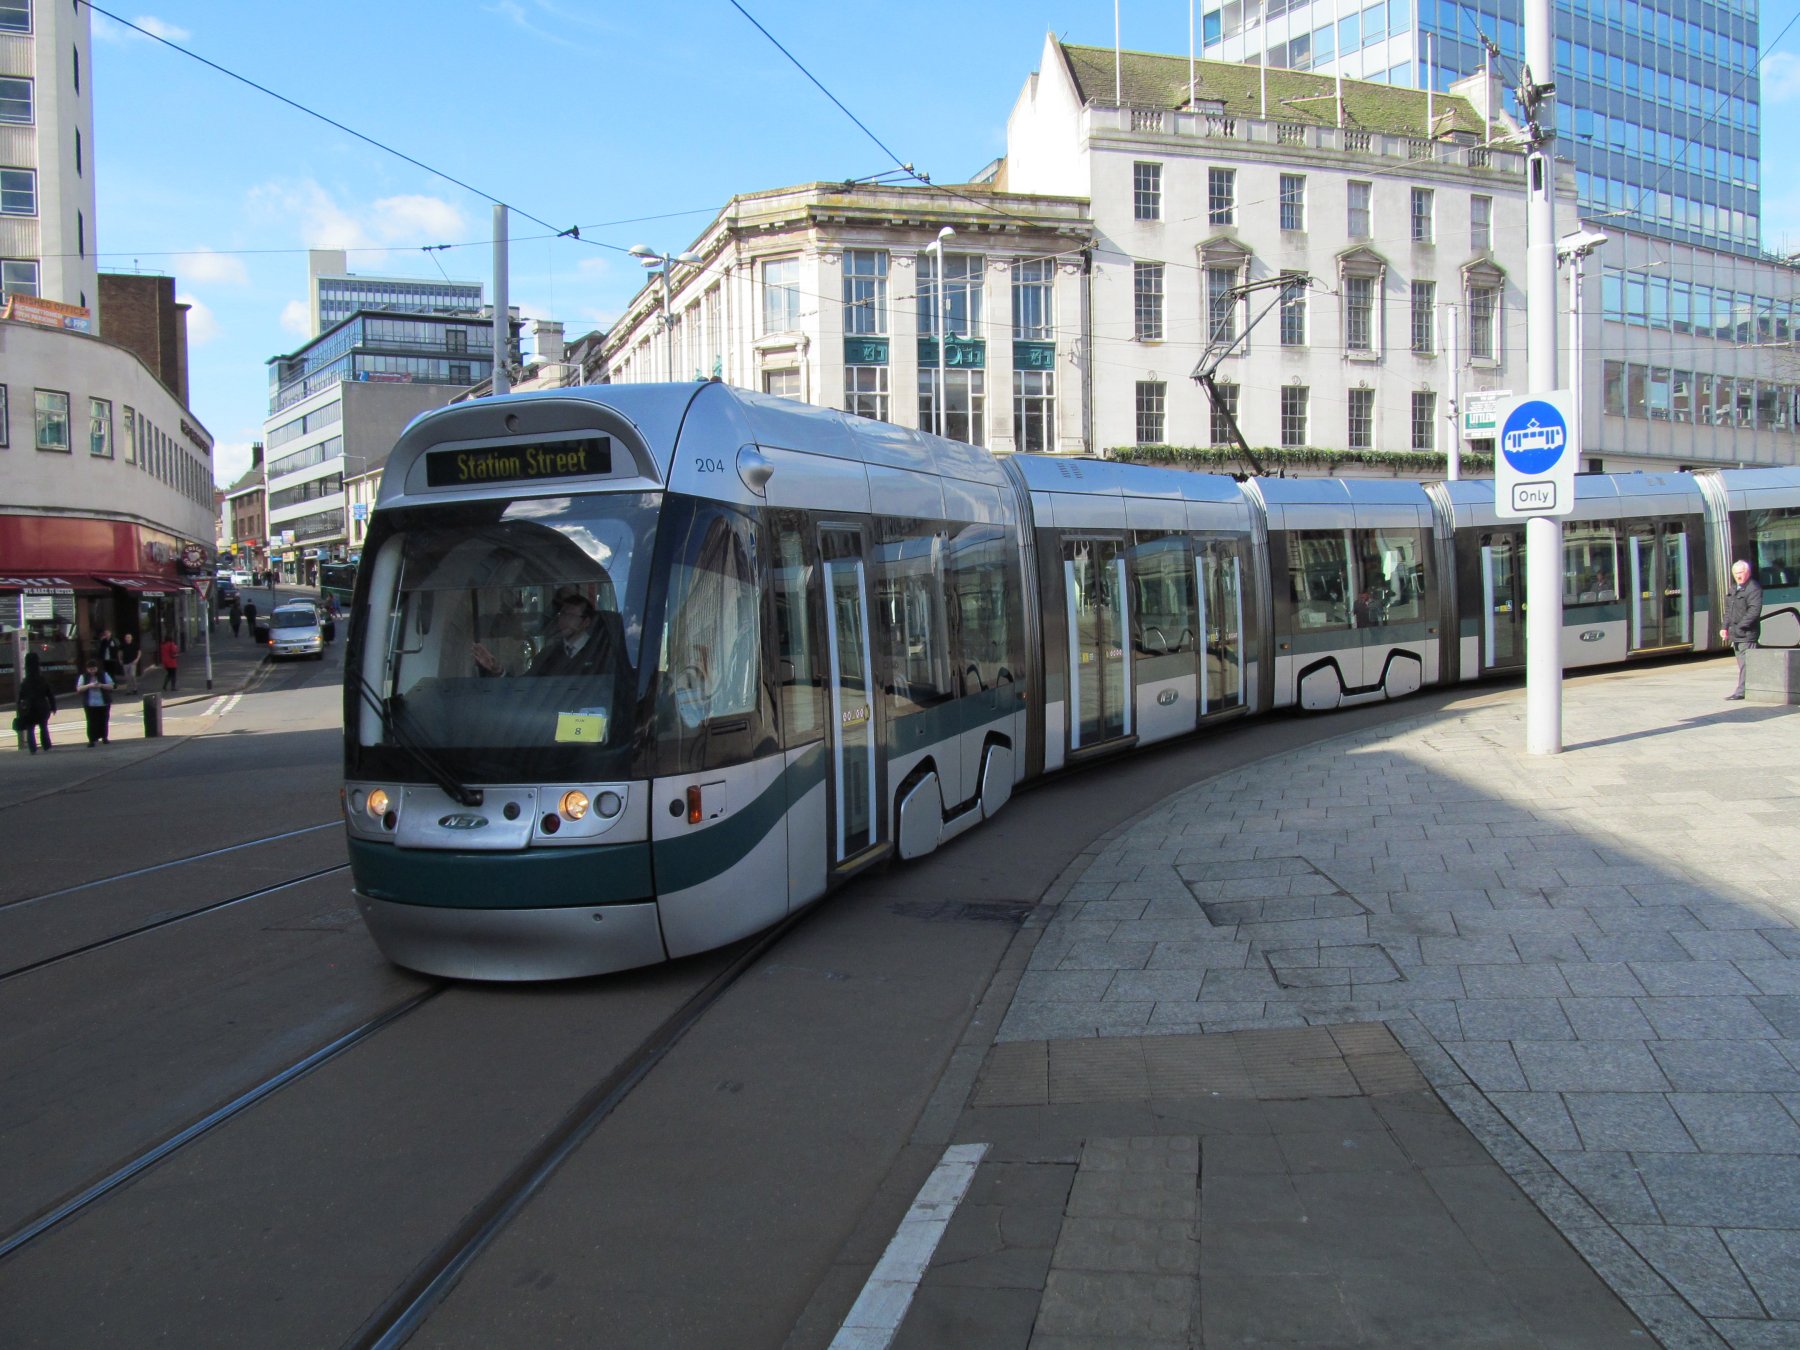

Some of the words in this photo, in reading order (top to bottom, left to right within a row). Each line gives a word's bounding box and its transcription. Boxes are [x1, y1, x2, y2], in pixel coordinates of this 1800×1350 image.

[457, 453, 520, 481] Station
[525, 448, 587, 475] Street
[695, 458, 725, 473] 204
[1519, 489, 1549, 503] Only
[574, 727, 582, 736] 8
[444, 816, 483, 827] NET
